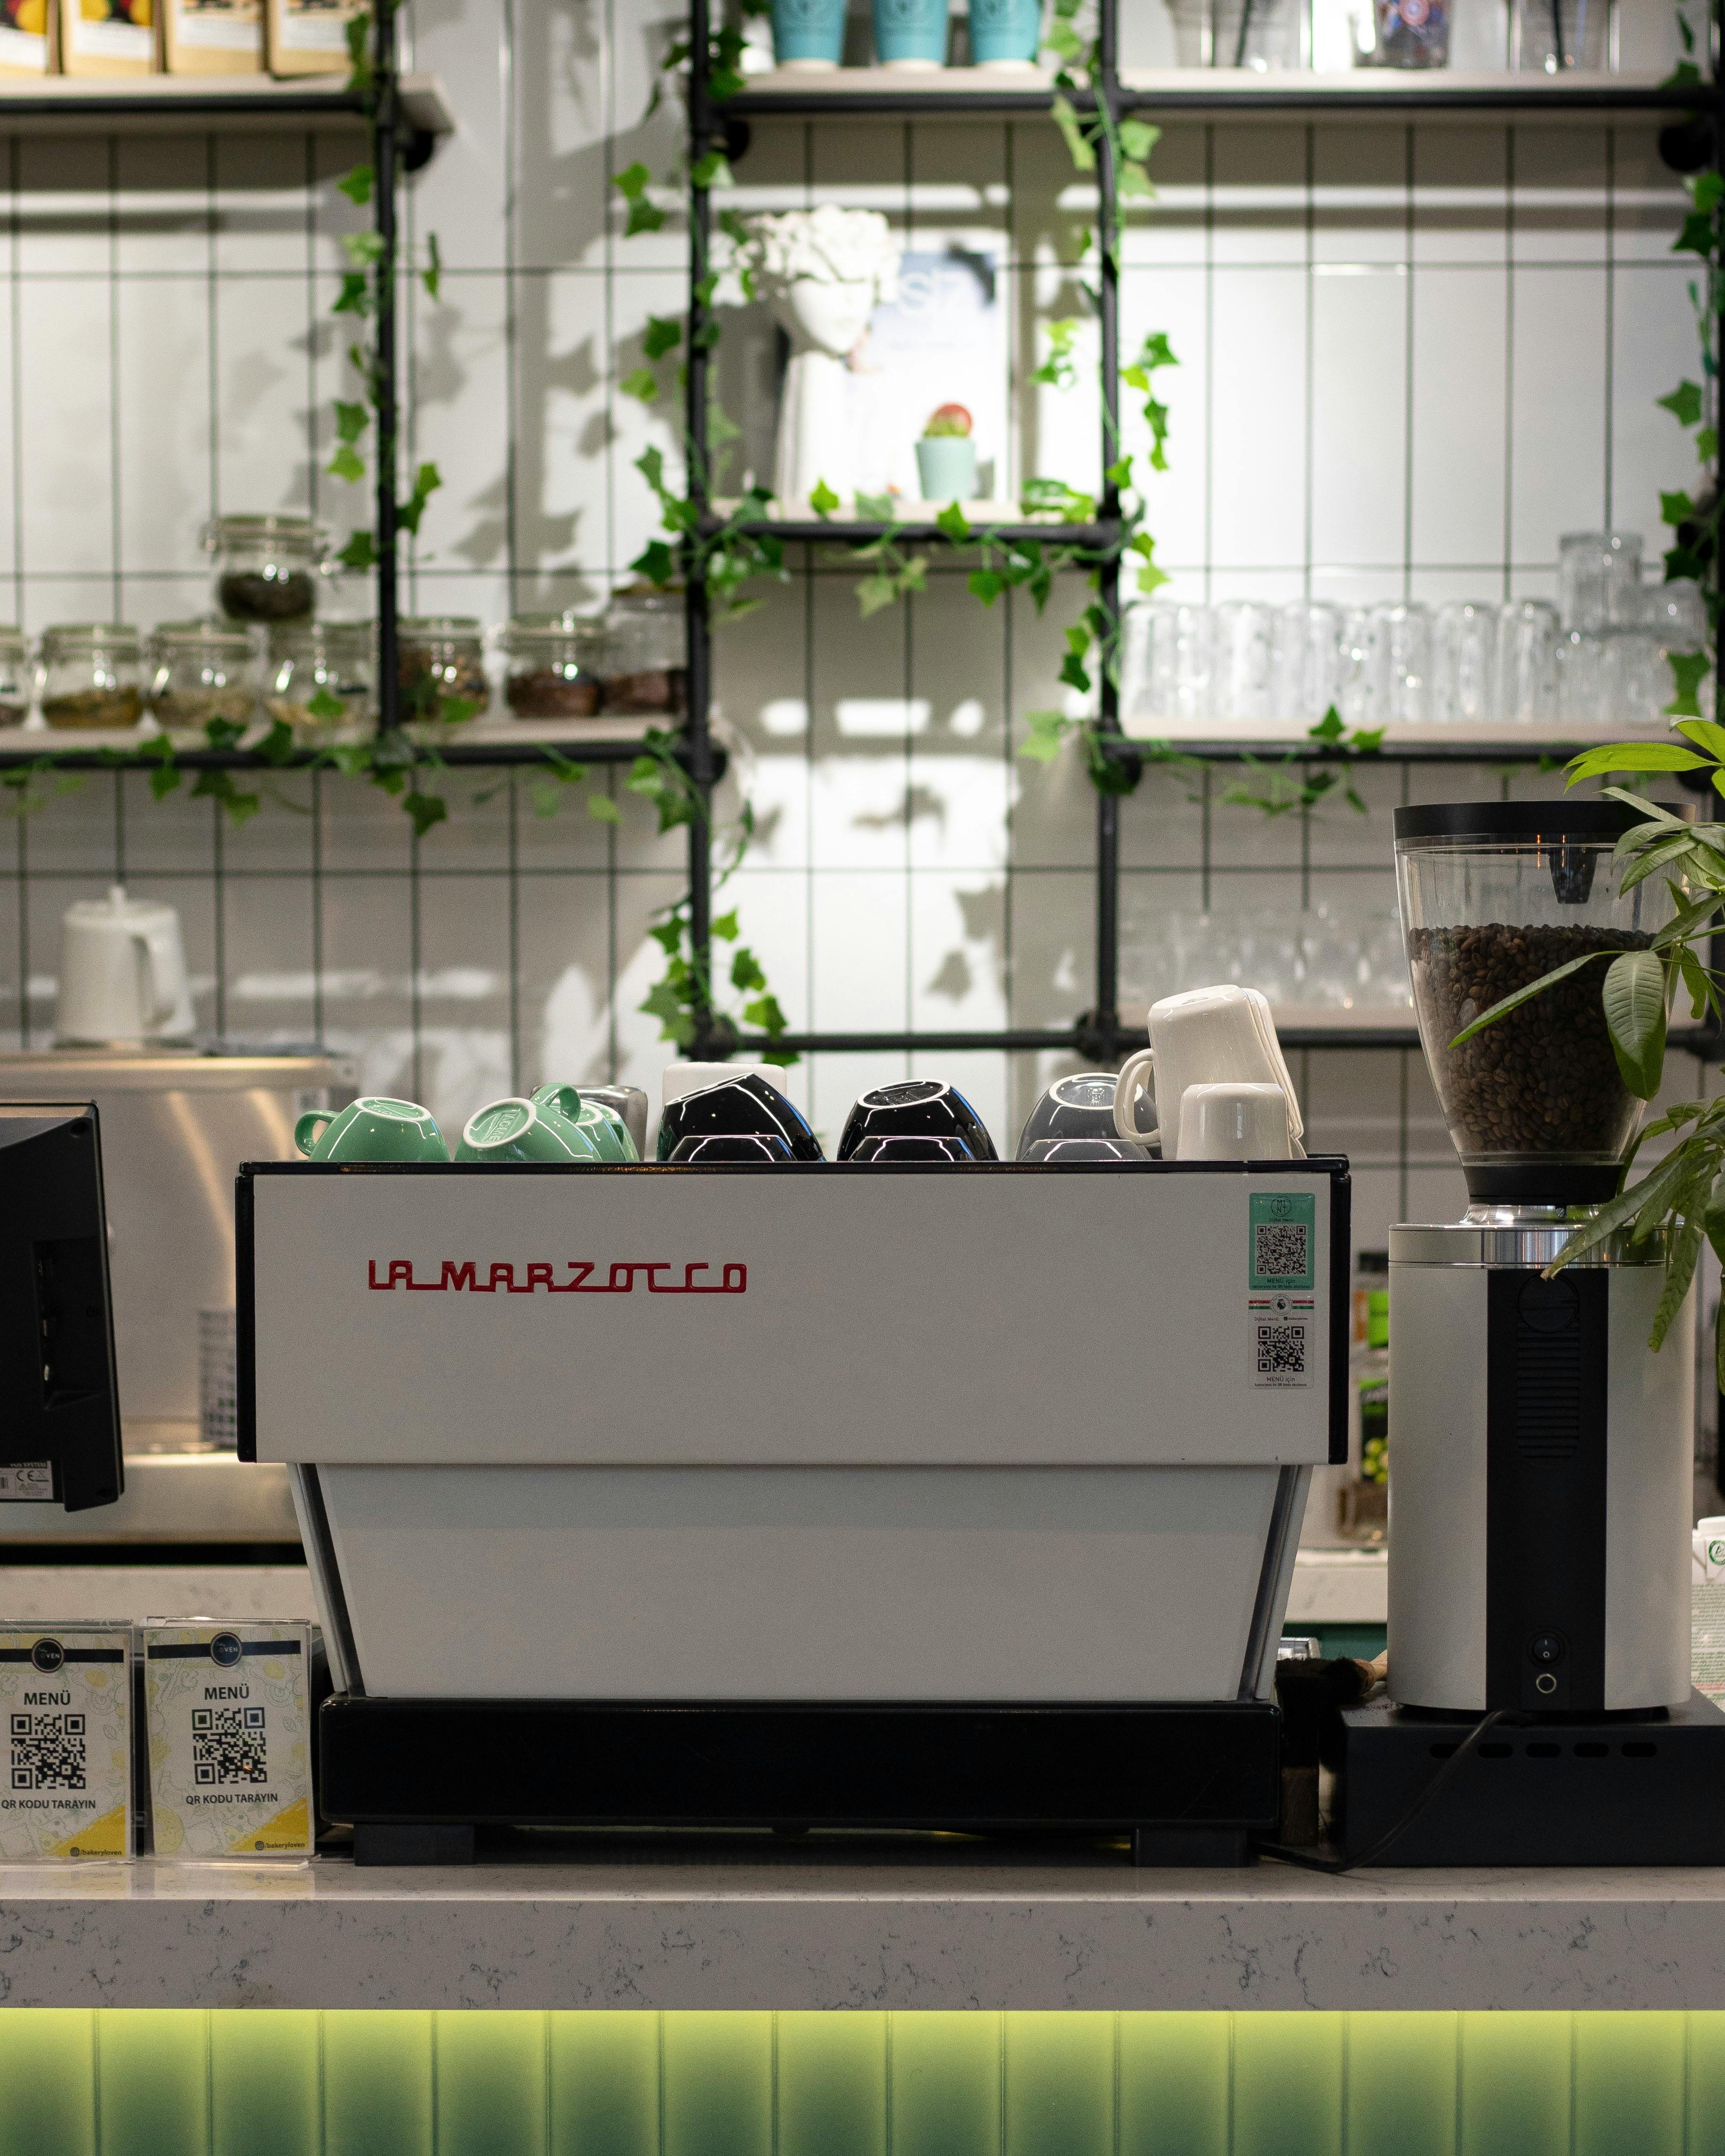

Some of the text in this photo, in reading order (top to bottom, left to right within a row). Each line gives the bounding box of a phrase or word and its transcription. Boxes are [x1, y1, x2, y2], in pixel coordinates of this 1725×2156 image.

[442, 1261, 747, 1293] MARZOCCO
[24, 1689, 71, 1705] MENÜ
[204, 1683, 250, 1700] MENÜ
[1, 1799, 96, 1810] QR KODU TARAYIN
[186, 1793, 278, 1805] QR KODU TARAYIN
